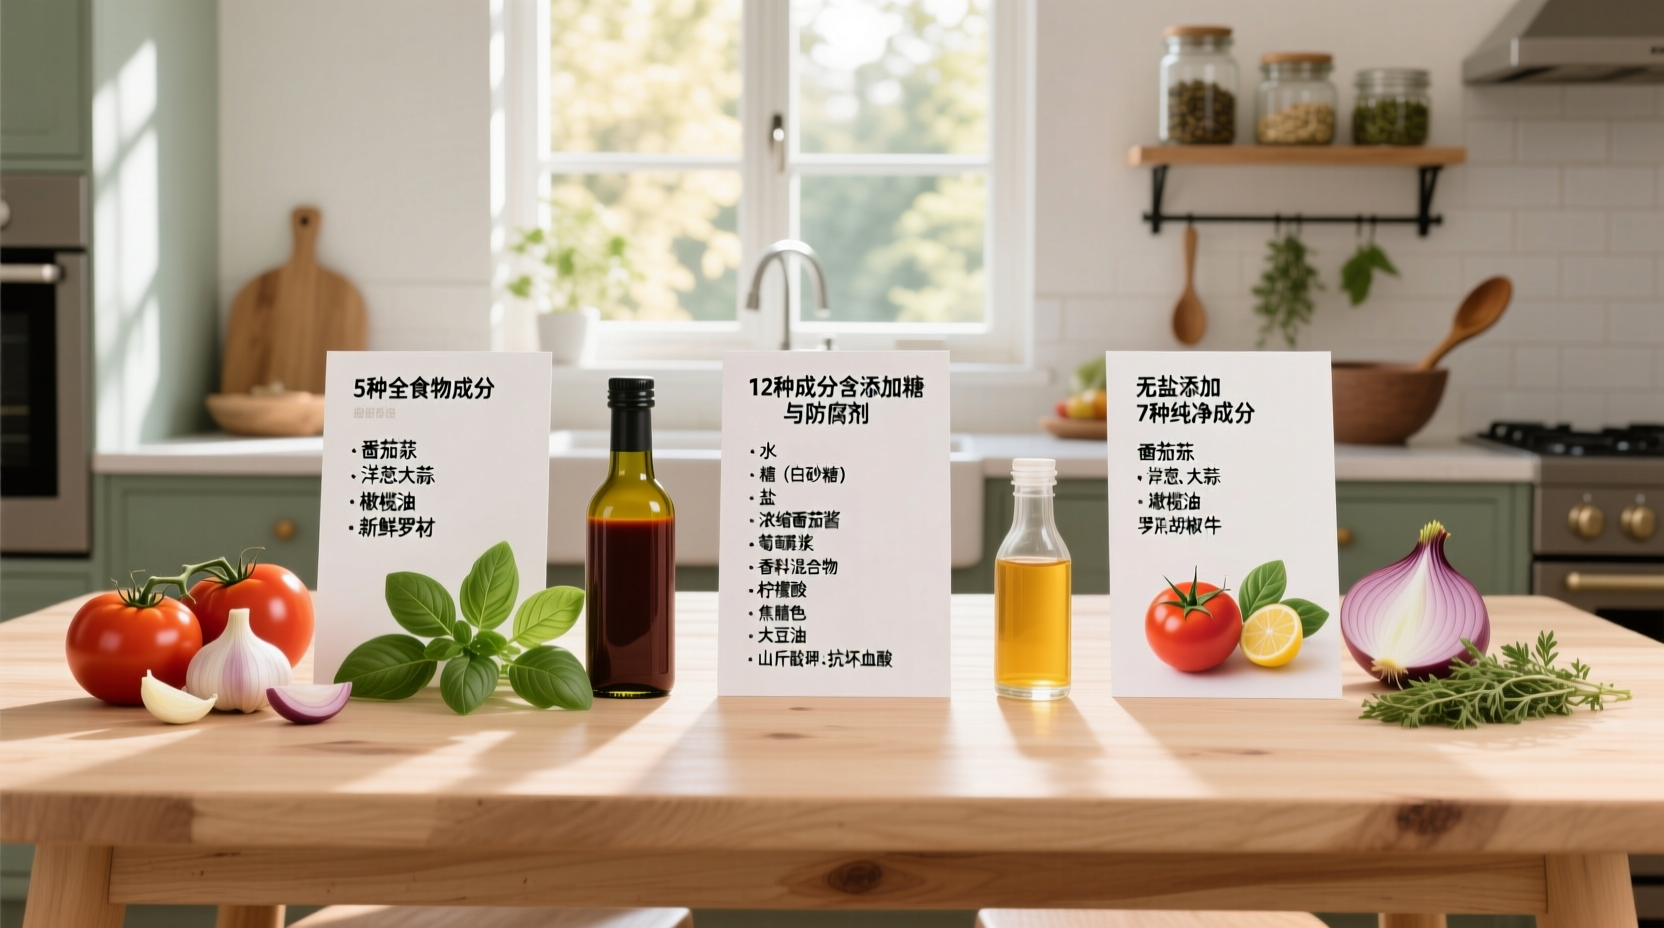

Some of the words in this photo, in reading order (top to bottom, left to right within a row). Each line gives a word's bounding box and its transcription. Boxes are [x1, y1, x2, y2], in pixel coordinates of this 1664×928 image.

[354, 376, 494, 399] 5种全食物成分
[750, 375, 925, 398] 12种成分含添加糖
[1137, 375, 1220, 397] 无盐添加
[784, 401, 868, 425] 与防腐剂
[1137, 401, 1255, 424] 7种纯净成分
[760, 442, 776, 459] 水
[760, 488, 777, 506] 盐
[758, 558, 839, 575] 香料混合物
[758, 626, 807, 643] 大豆油
